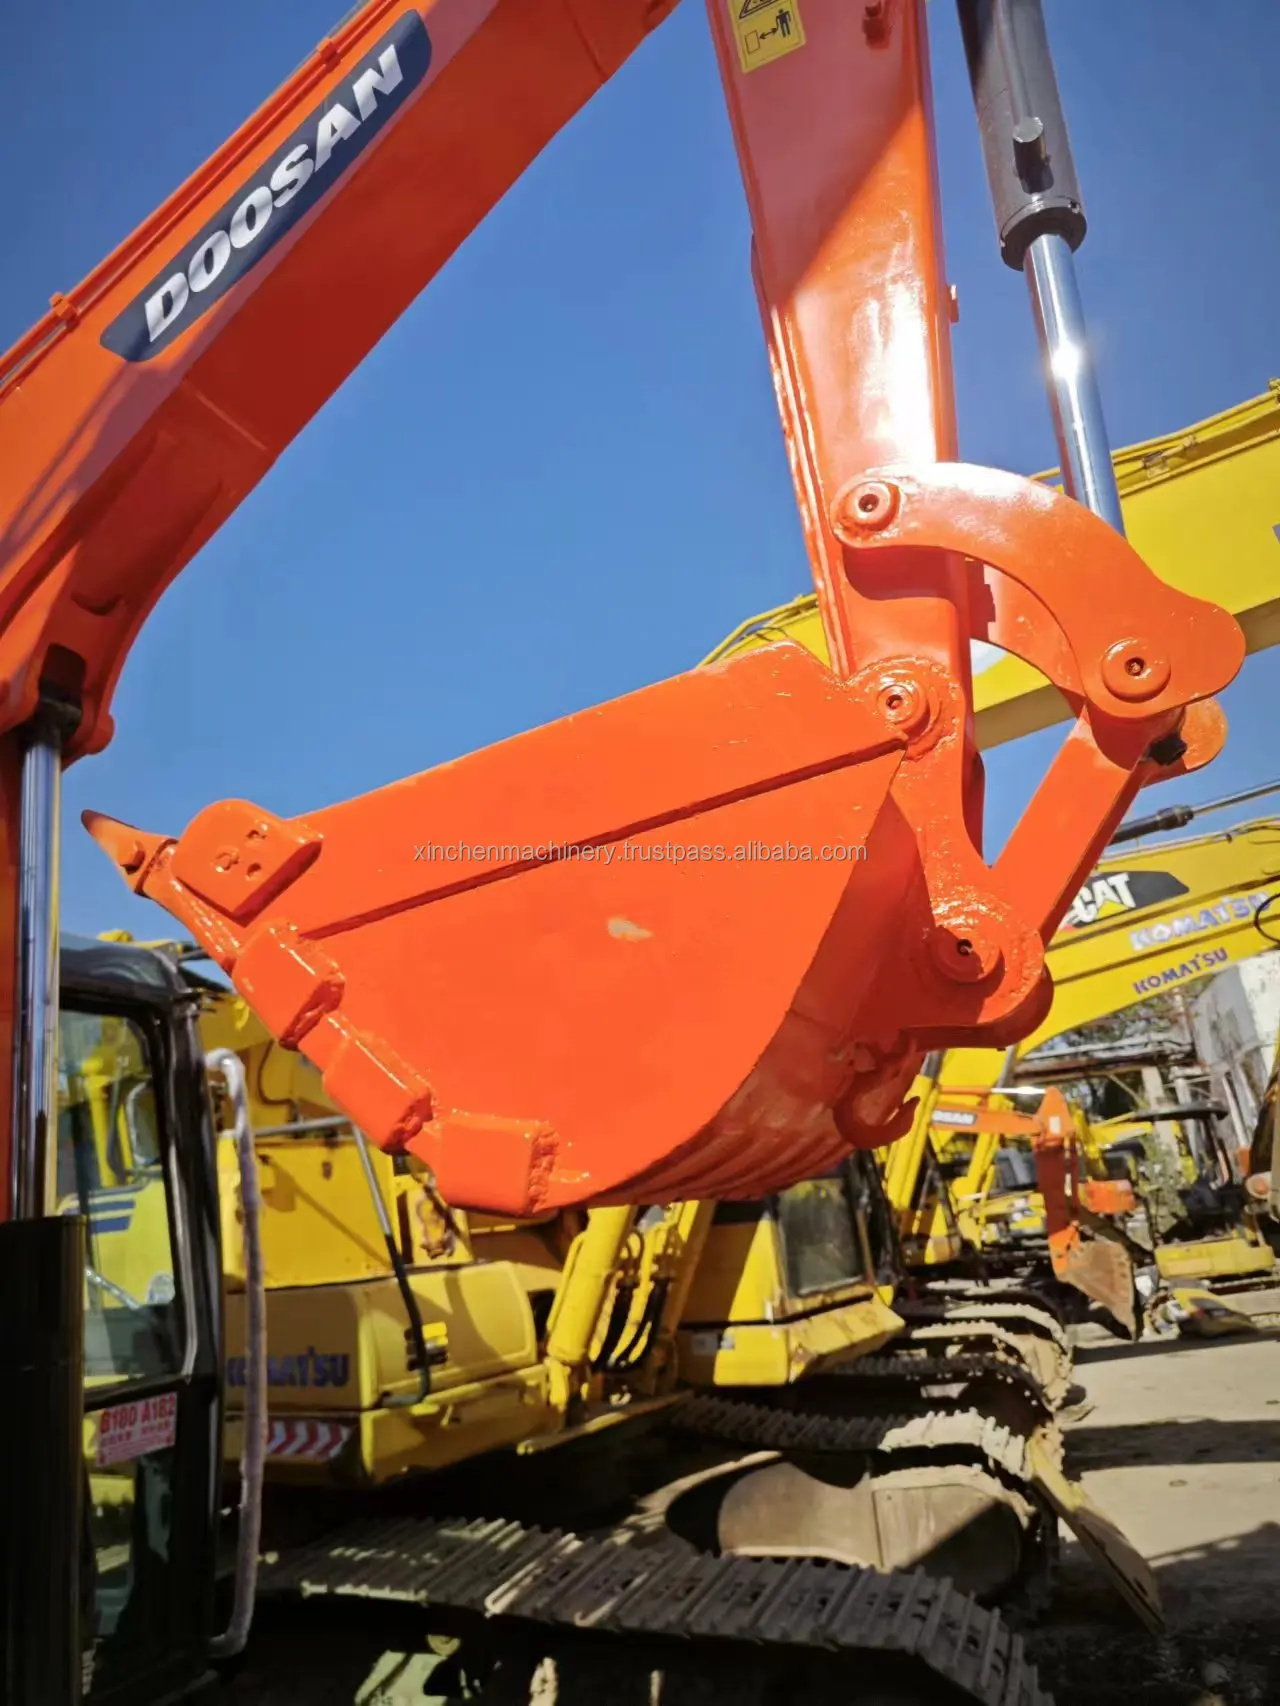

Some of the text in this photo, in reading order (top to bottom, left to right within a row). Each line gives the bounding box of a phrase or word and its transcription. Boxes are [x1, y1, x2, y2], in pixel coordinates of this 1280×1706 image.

[145, 44, 404, 343] DOOSAN
[1075, 872, 1137, 924] CAT
[1129, 891, 1271, 951] KOMATSU
[1132, 947, 1229, 995] KOMATSU
[226, 1345, 350, 1388] KMATSU
